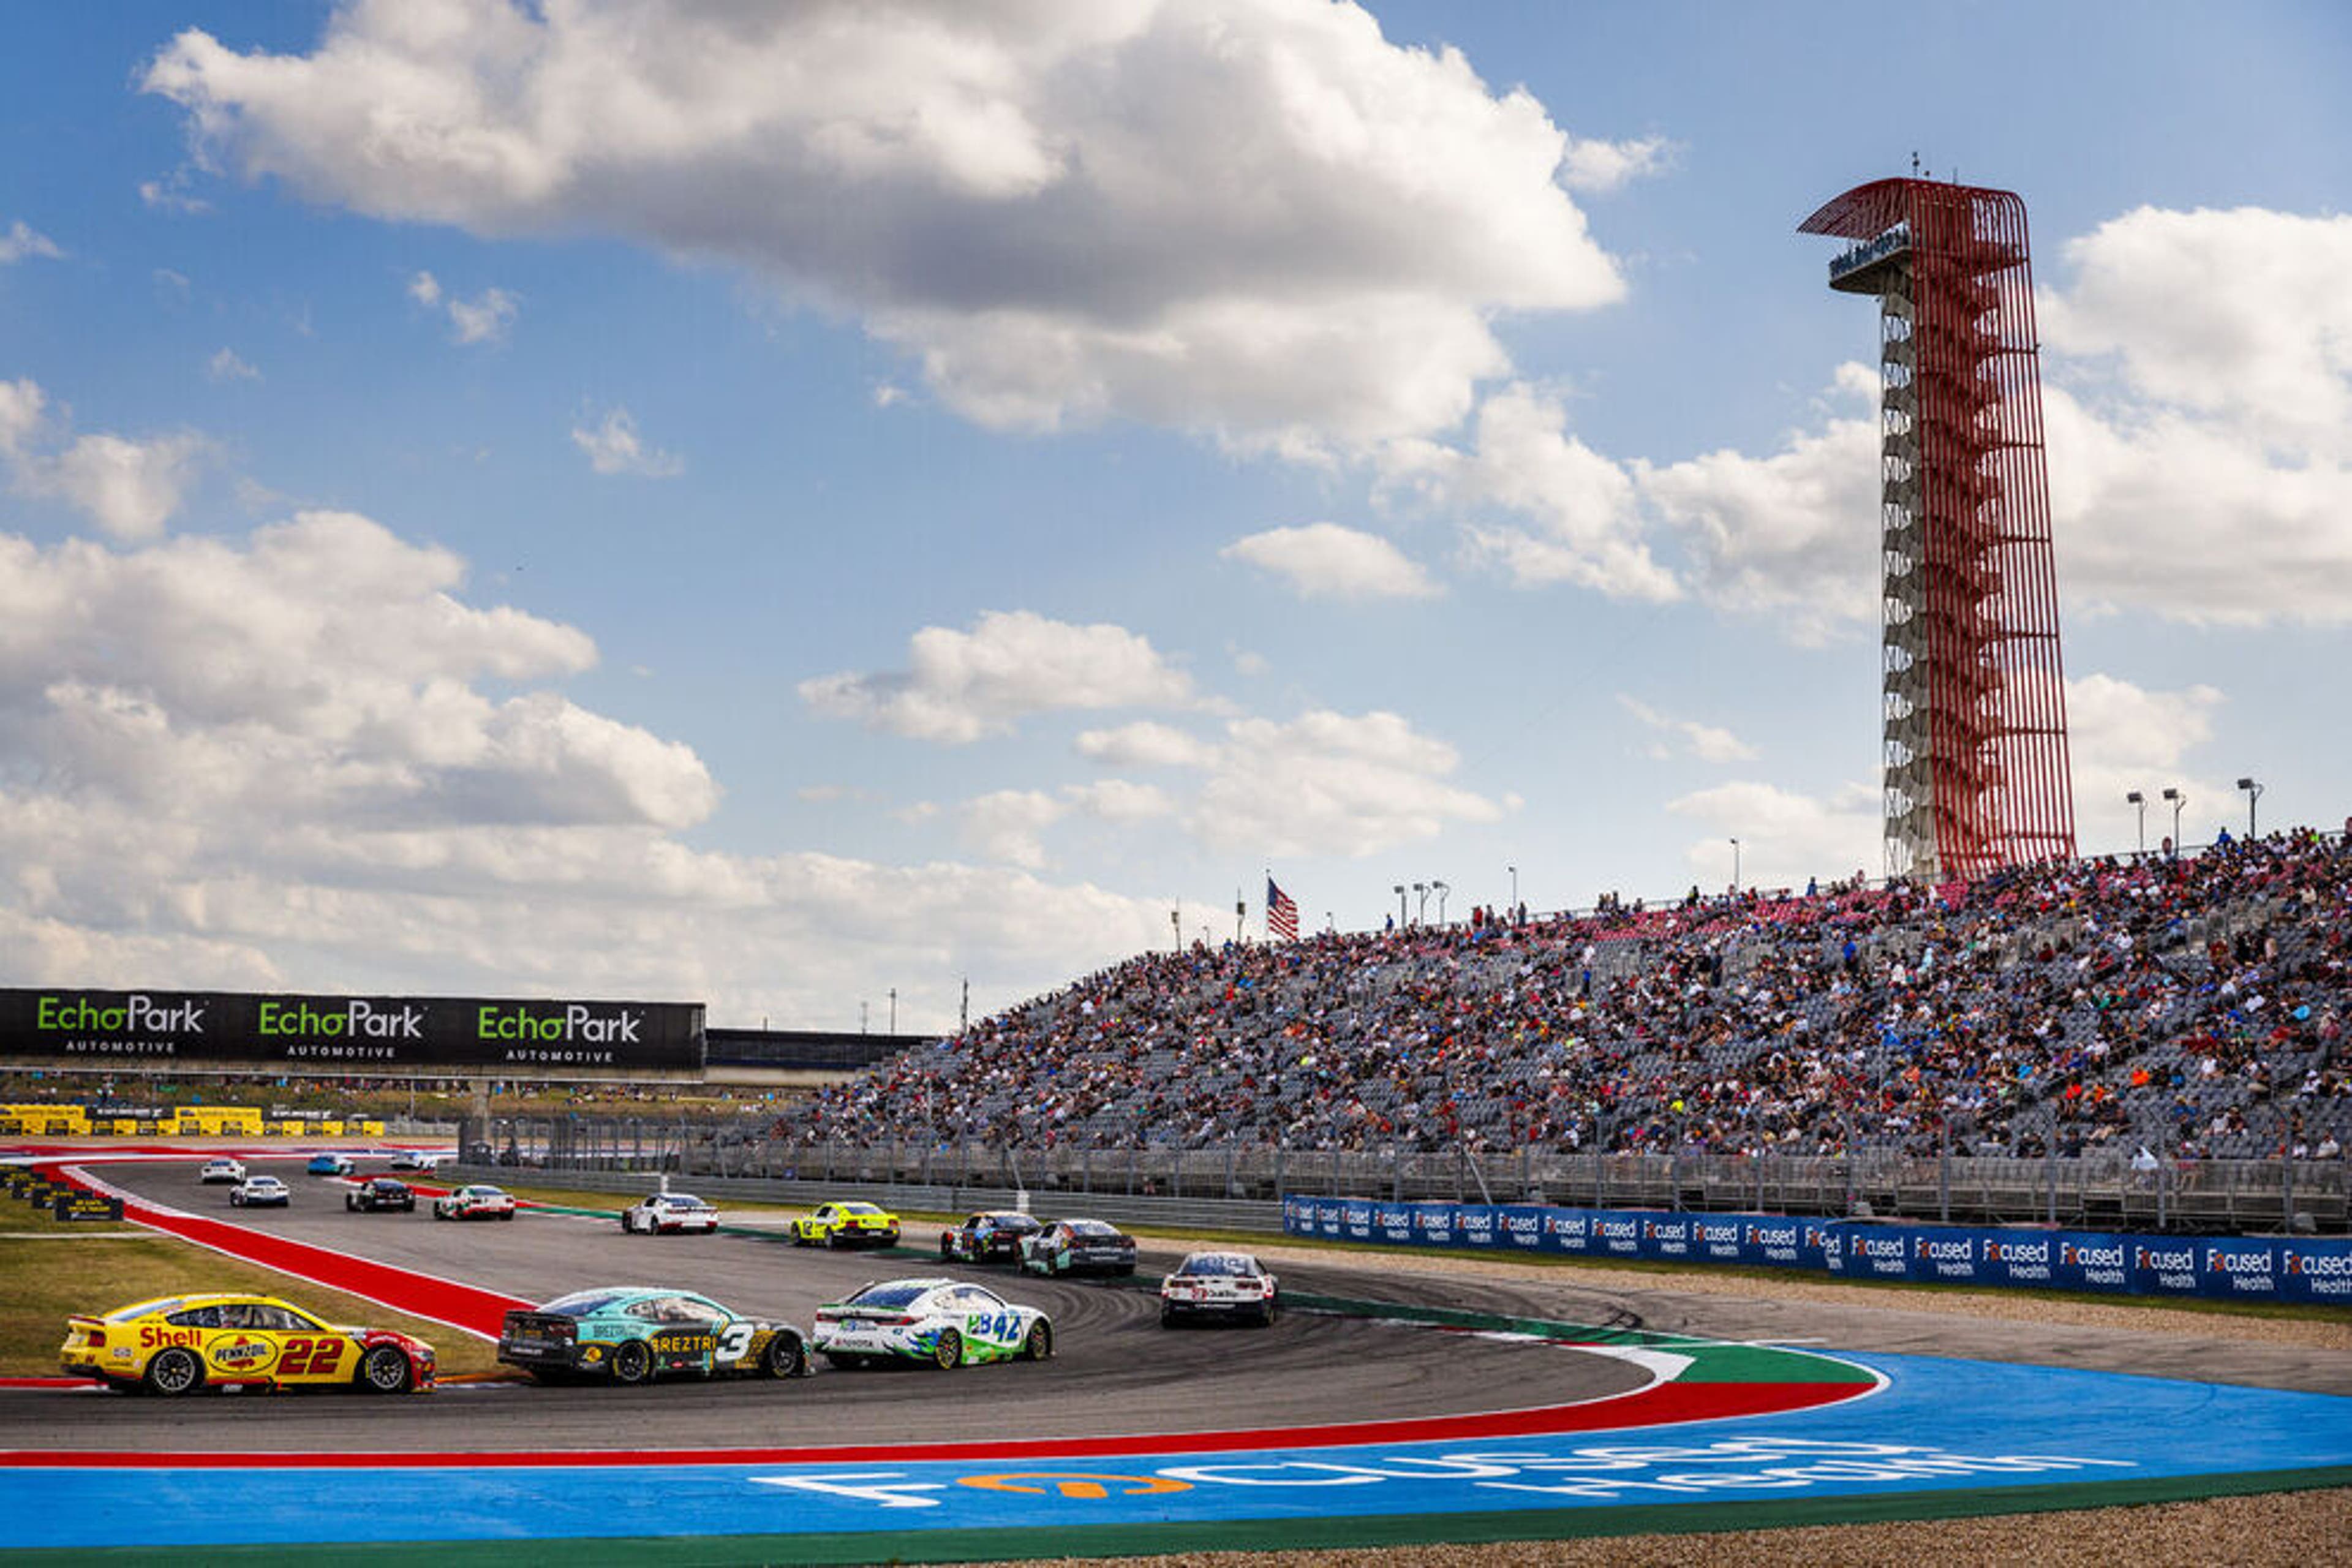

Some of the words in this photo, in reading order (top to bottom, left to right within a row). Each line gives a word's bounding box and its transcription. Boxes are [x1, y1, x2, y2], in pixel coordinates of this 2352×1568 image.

[37, 995, 205, 1032] EchoPark
[260, 1001, 422, 1038] EchoPark
[478, 1005, 640, 1042] EchoPark
[67, 1041, 175, 1052] AUTOMOTIVE
[288, 1046, 394, 1058] AUTOMOTIVE
[507, 1050, 612, 1062] AUTOMOTIVE
[1544, 1215, 1585, 1235] Focused
[1592, 1217, 1637, 1238] Focused
[1643, 1219, 1686, 1240] Focused
[1693, 1221, 1738, 1242] Focused
[1745, 1224, 1796, 1246] Focused
[1709, 1244, 1738, 1256] Health
[1765, 1246, 1796, 1259] Health
[1852, 1234, 1904, 1257] Focused
[1915, 1236, 1972, 1260] Focused
[1983, 1238, 2049, 1262] Focused
[2060, 1242, 2124, 1267] Focused
[1874, 1257, 1905, 1272] Health
[2135, 1245, 2194, 1270] Focused
[2206, 1248, 2272, 1272] Focused
[1937, 1261, 1973, 1276] Health
[2009, 1263, 2049, 1279] Health
[2085, 1267, 2125, 1284] Health
[2159, 1272, 2196, 1287] Health
[2233, 1275, 2274, 1291] Health
[140, 1326, 202, 1348] Shell
[651, 1335, 717, 1354] BREZTRI
[715, 1321, 755, 1362] 3
[275, 1338, 344, 1375] 22
[1472, 1455, 2139, 1497] Health
